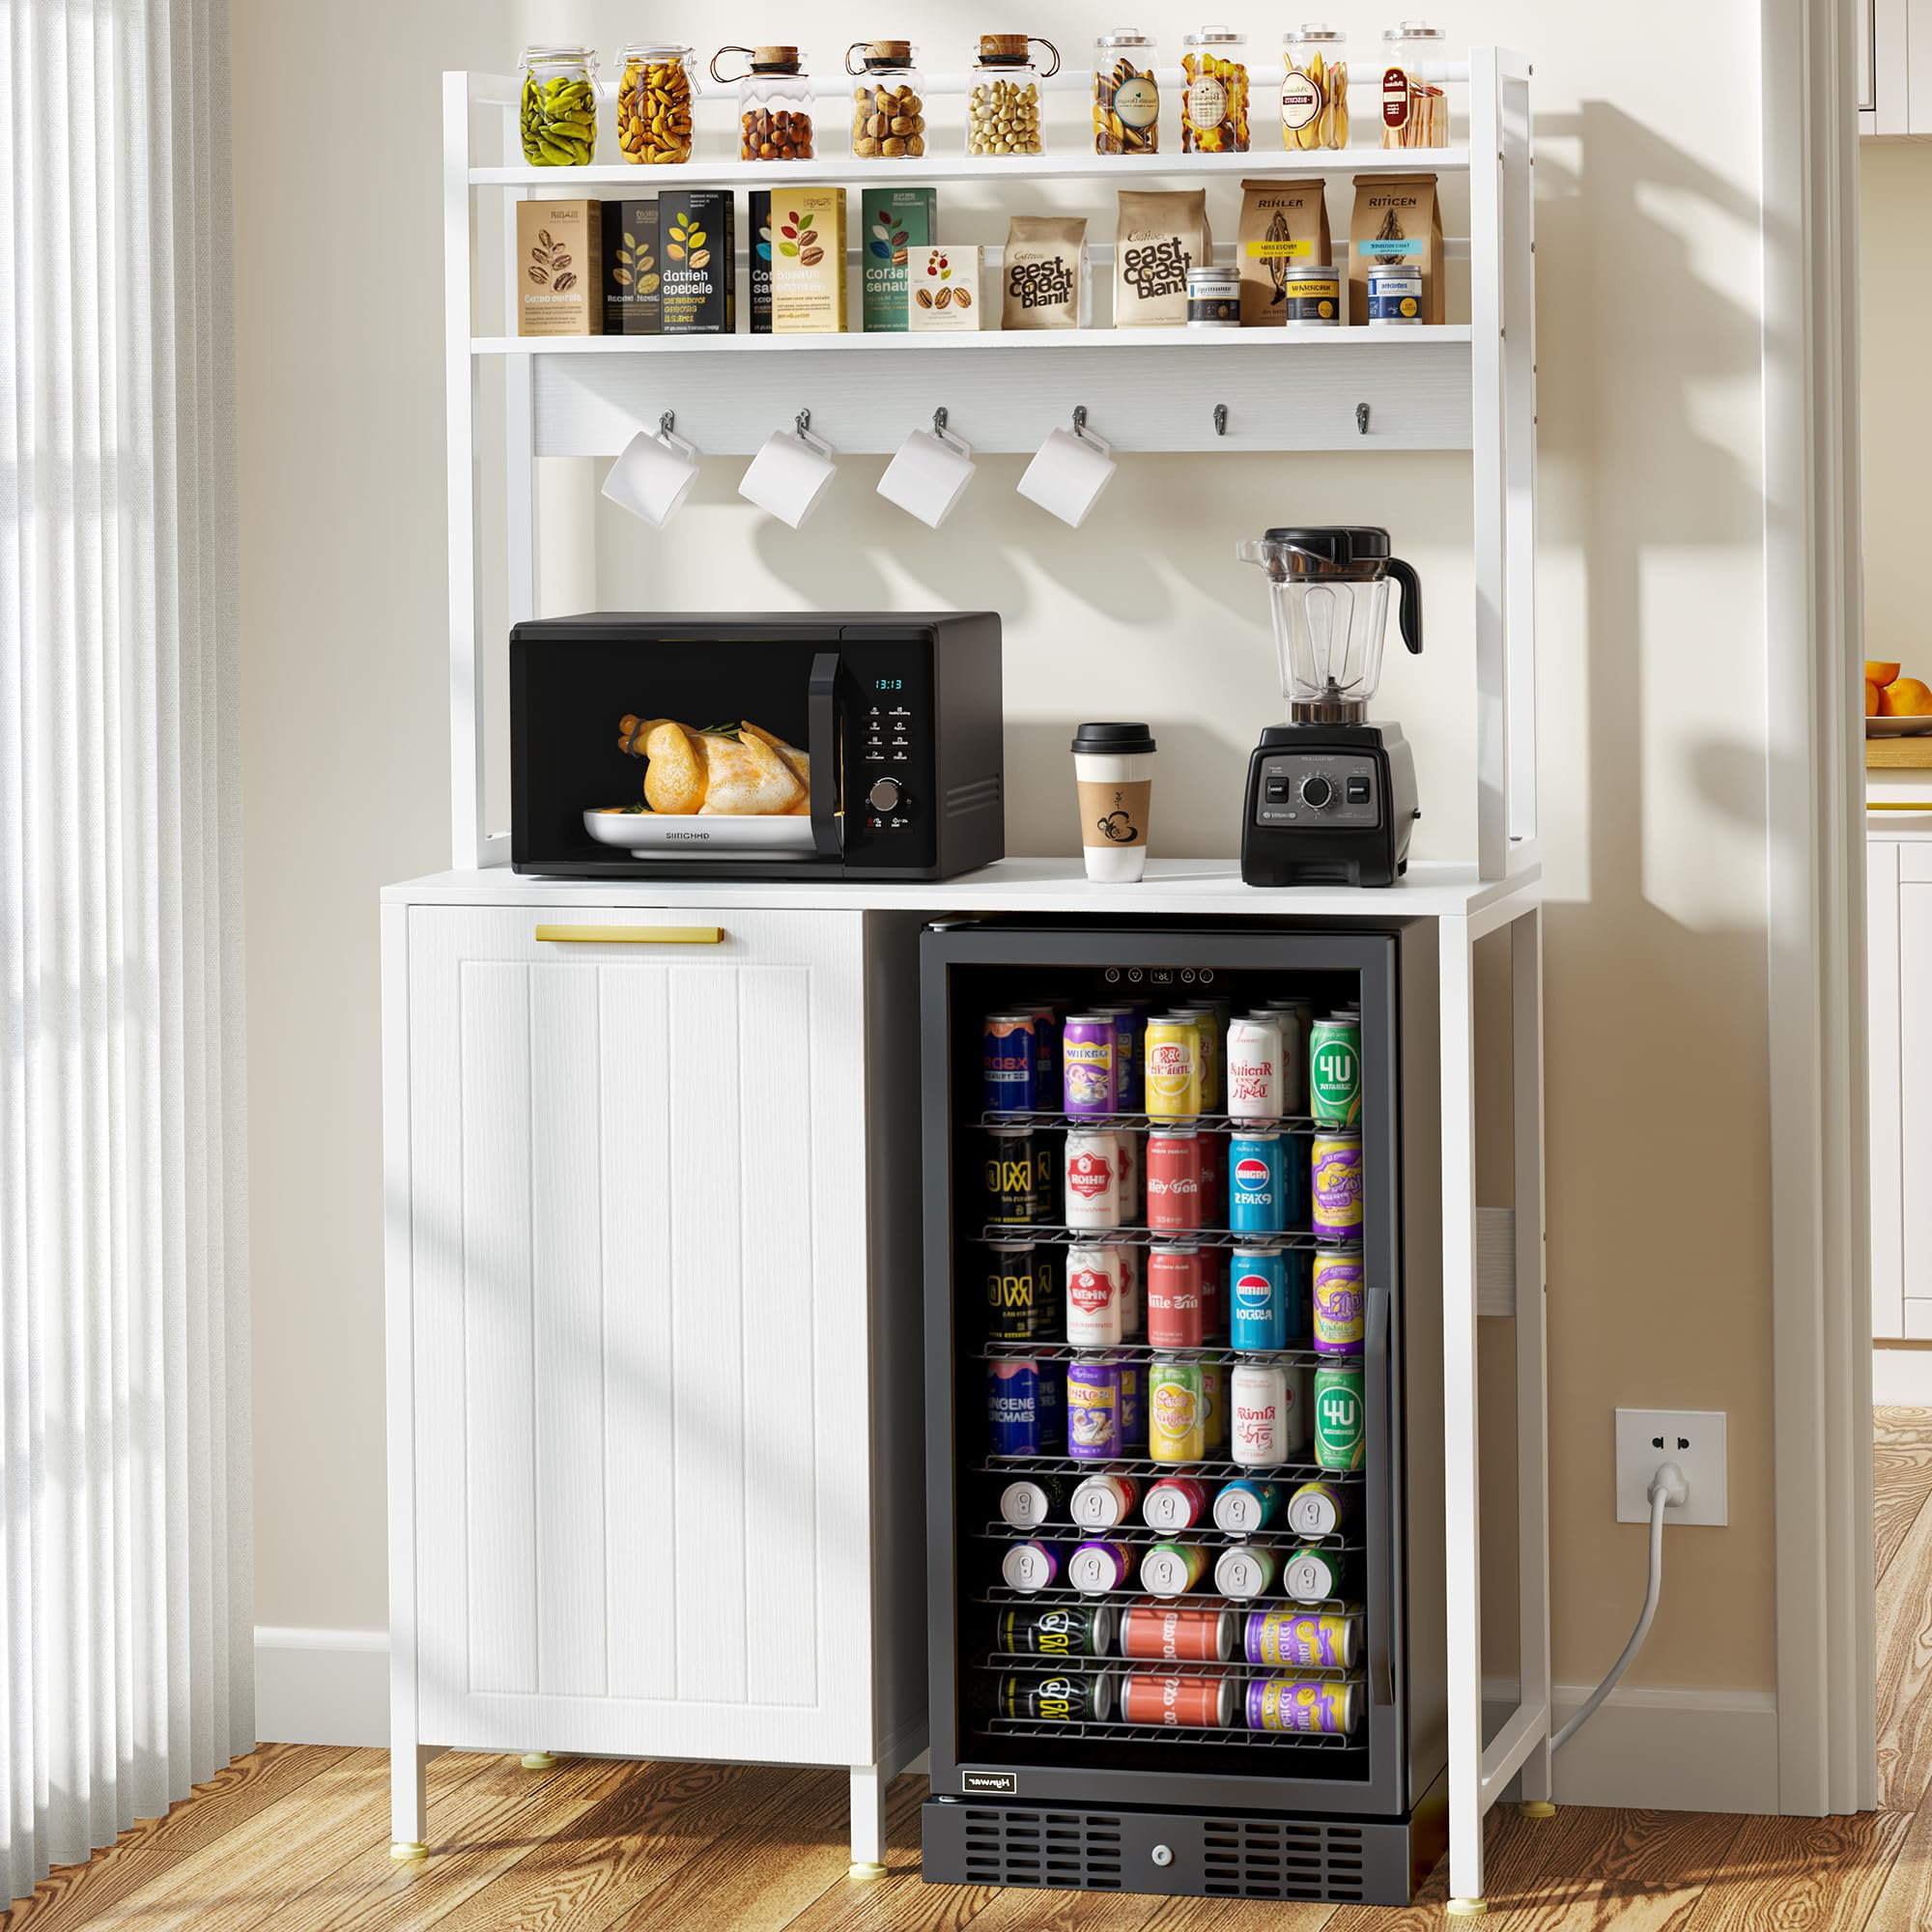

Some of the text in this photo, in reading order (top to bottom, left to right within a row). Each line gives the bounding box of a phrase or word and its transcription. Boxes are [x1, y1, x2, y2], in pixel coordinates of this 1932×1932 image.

[1124, 237, 1181, 268] east
[1123, 252, 1192, 285] coast
[875, 679, 902, 689] 13:13
[1320, 1055, 1351, 1083] 4U
